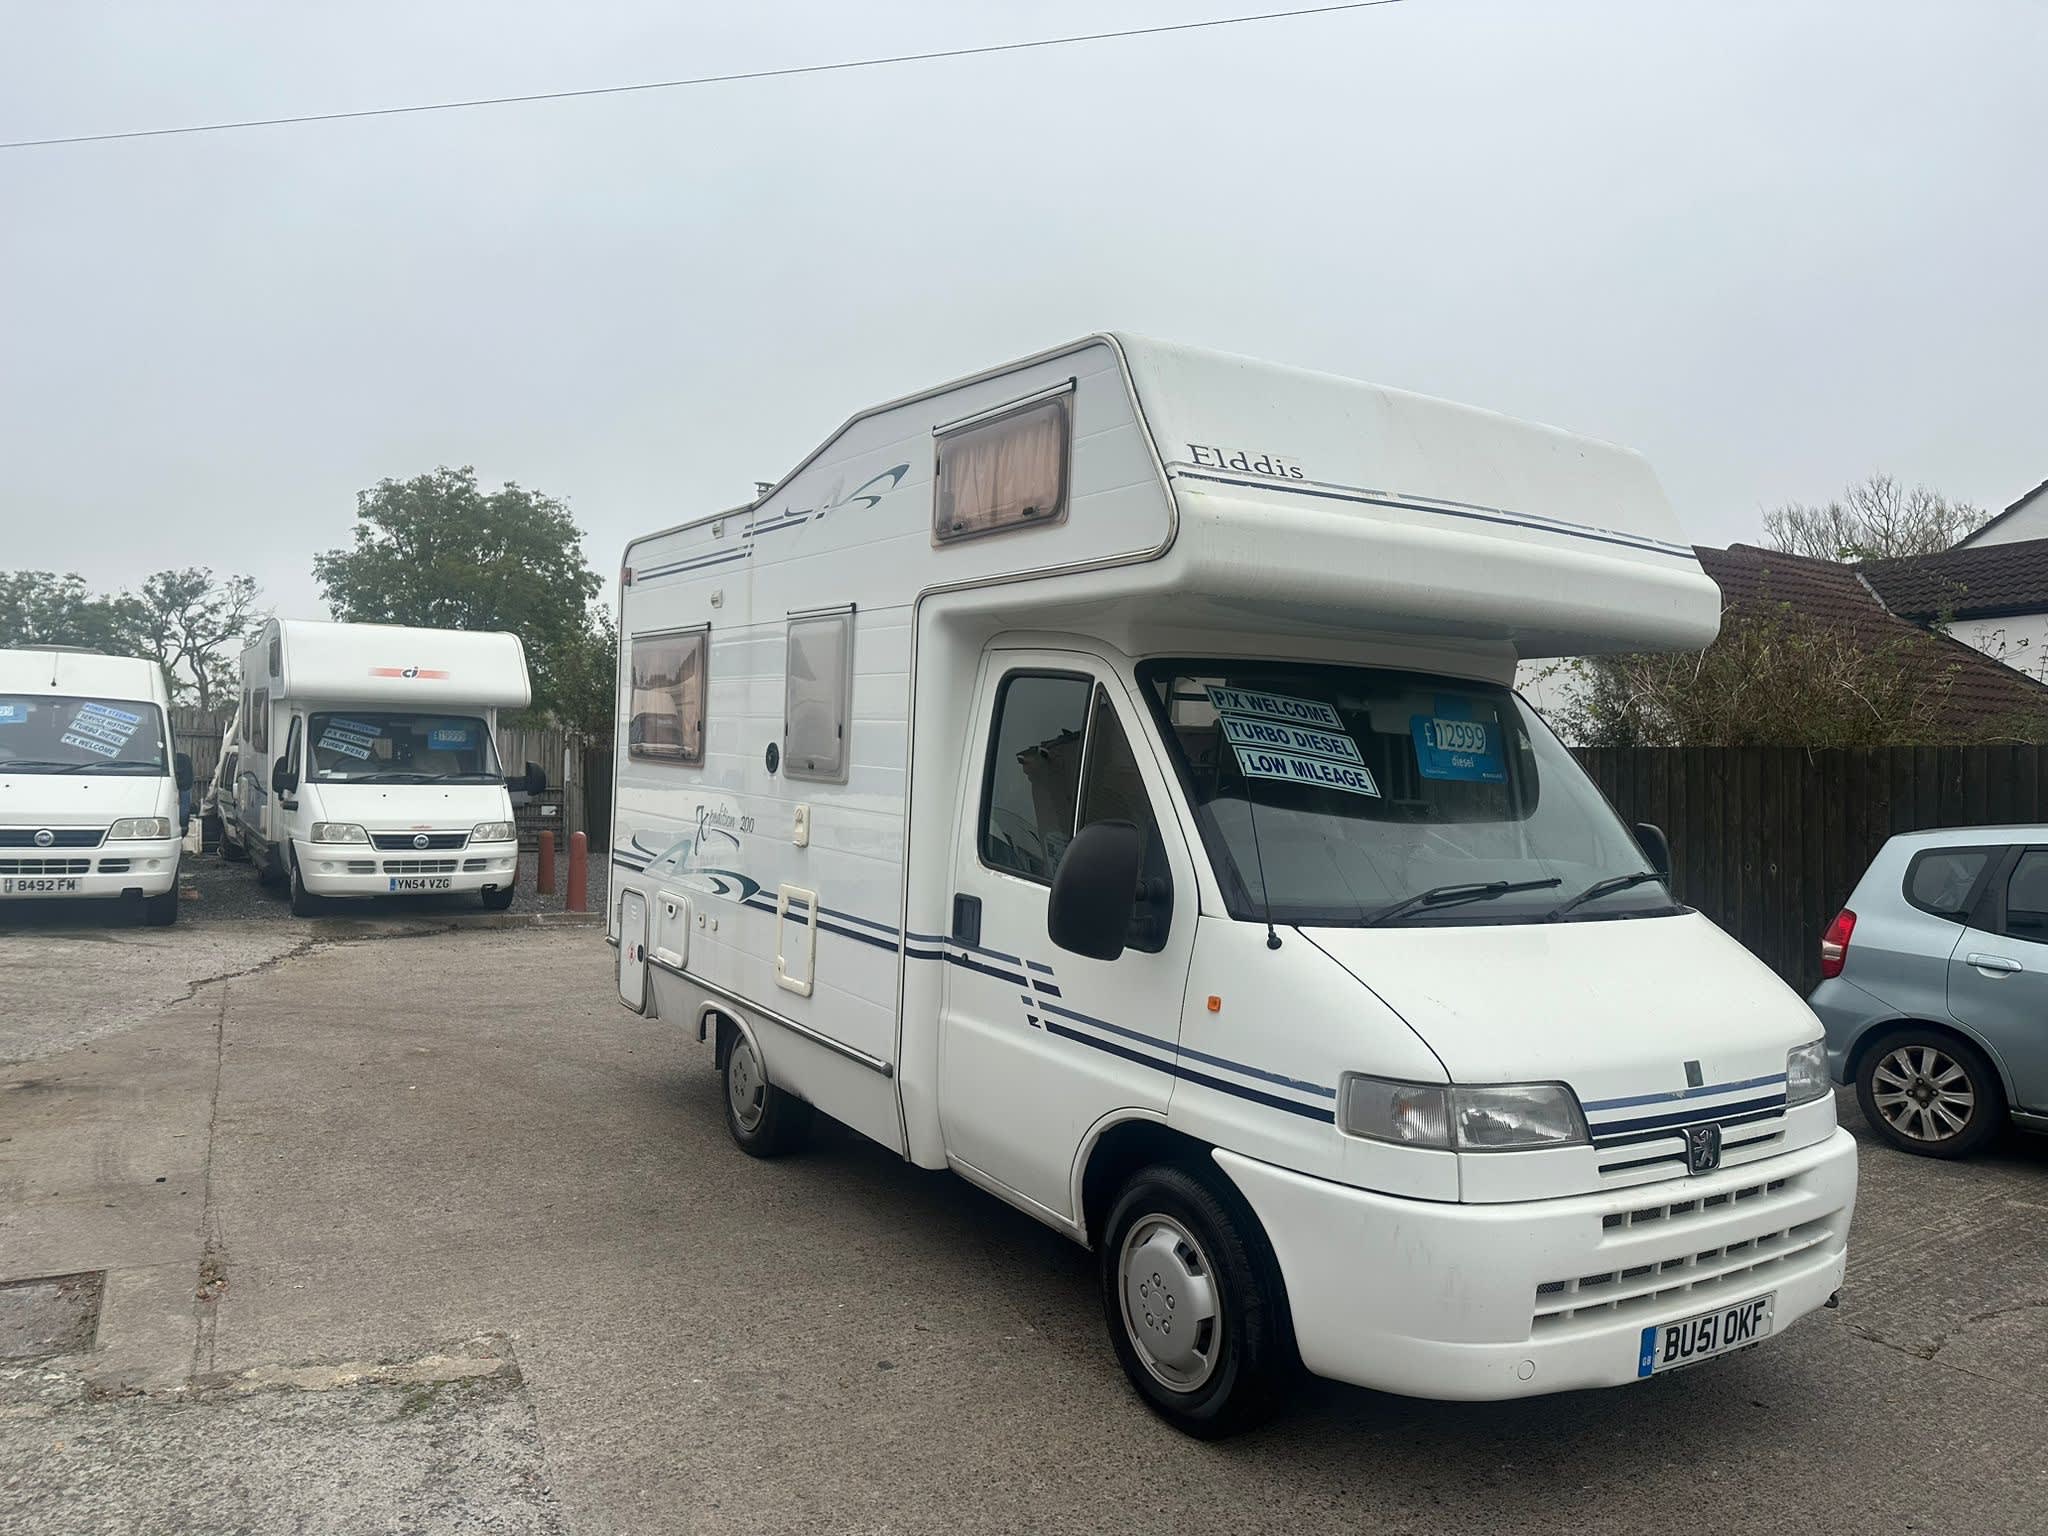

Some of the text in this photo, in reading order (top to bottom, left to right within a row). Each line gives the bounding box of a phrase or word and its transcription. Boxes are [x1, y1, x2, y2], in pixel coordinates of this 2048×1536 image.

[1185, 443, 1304, 480] Elddis
[1213, 690, 1335, 724] P/X WELCOME
[74, 722, 124, 744] TURBO DIESEL
[106, 720, 132, 733] HISTORY
[78, 739, 115, 755] WELCOME
[322, 740, 367, 758] TURBO DIESEL
[1228, 721, 1356, 758] TURBO DIESEL
[1247, 753, 1369, 790] LOW MILEAGE
[740, 815, 755, 833] 200
[58, 880, 76, 890] FM
[398, 879, 426, 889] YN54
[429, 879, 450, 889] VZG
[1663, 1300, 1766, 1363] BU51 OKF
